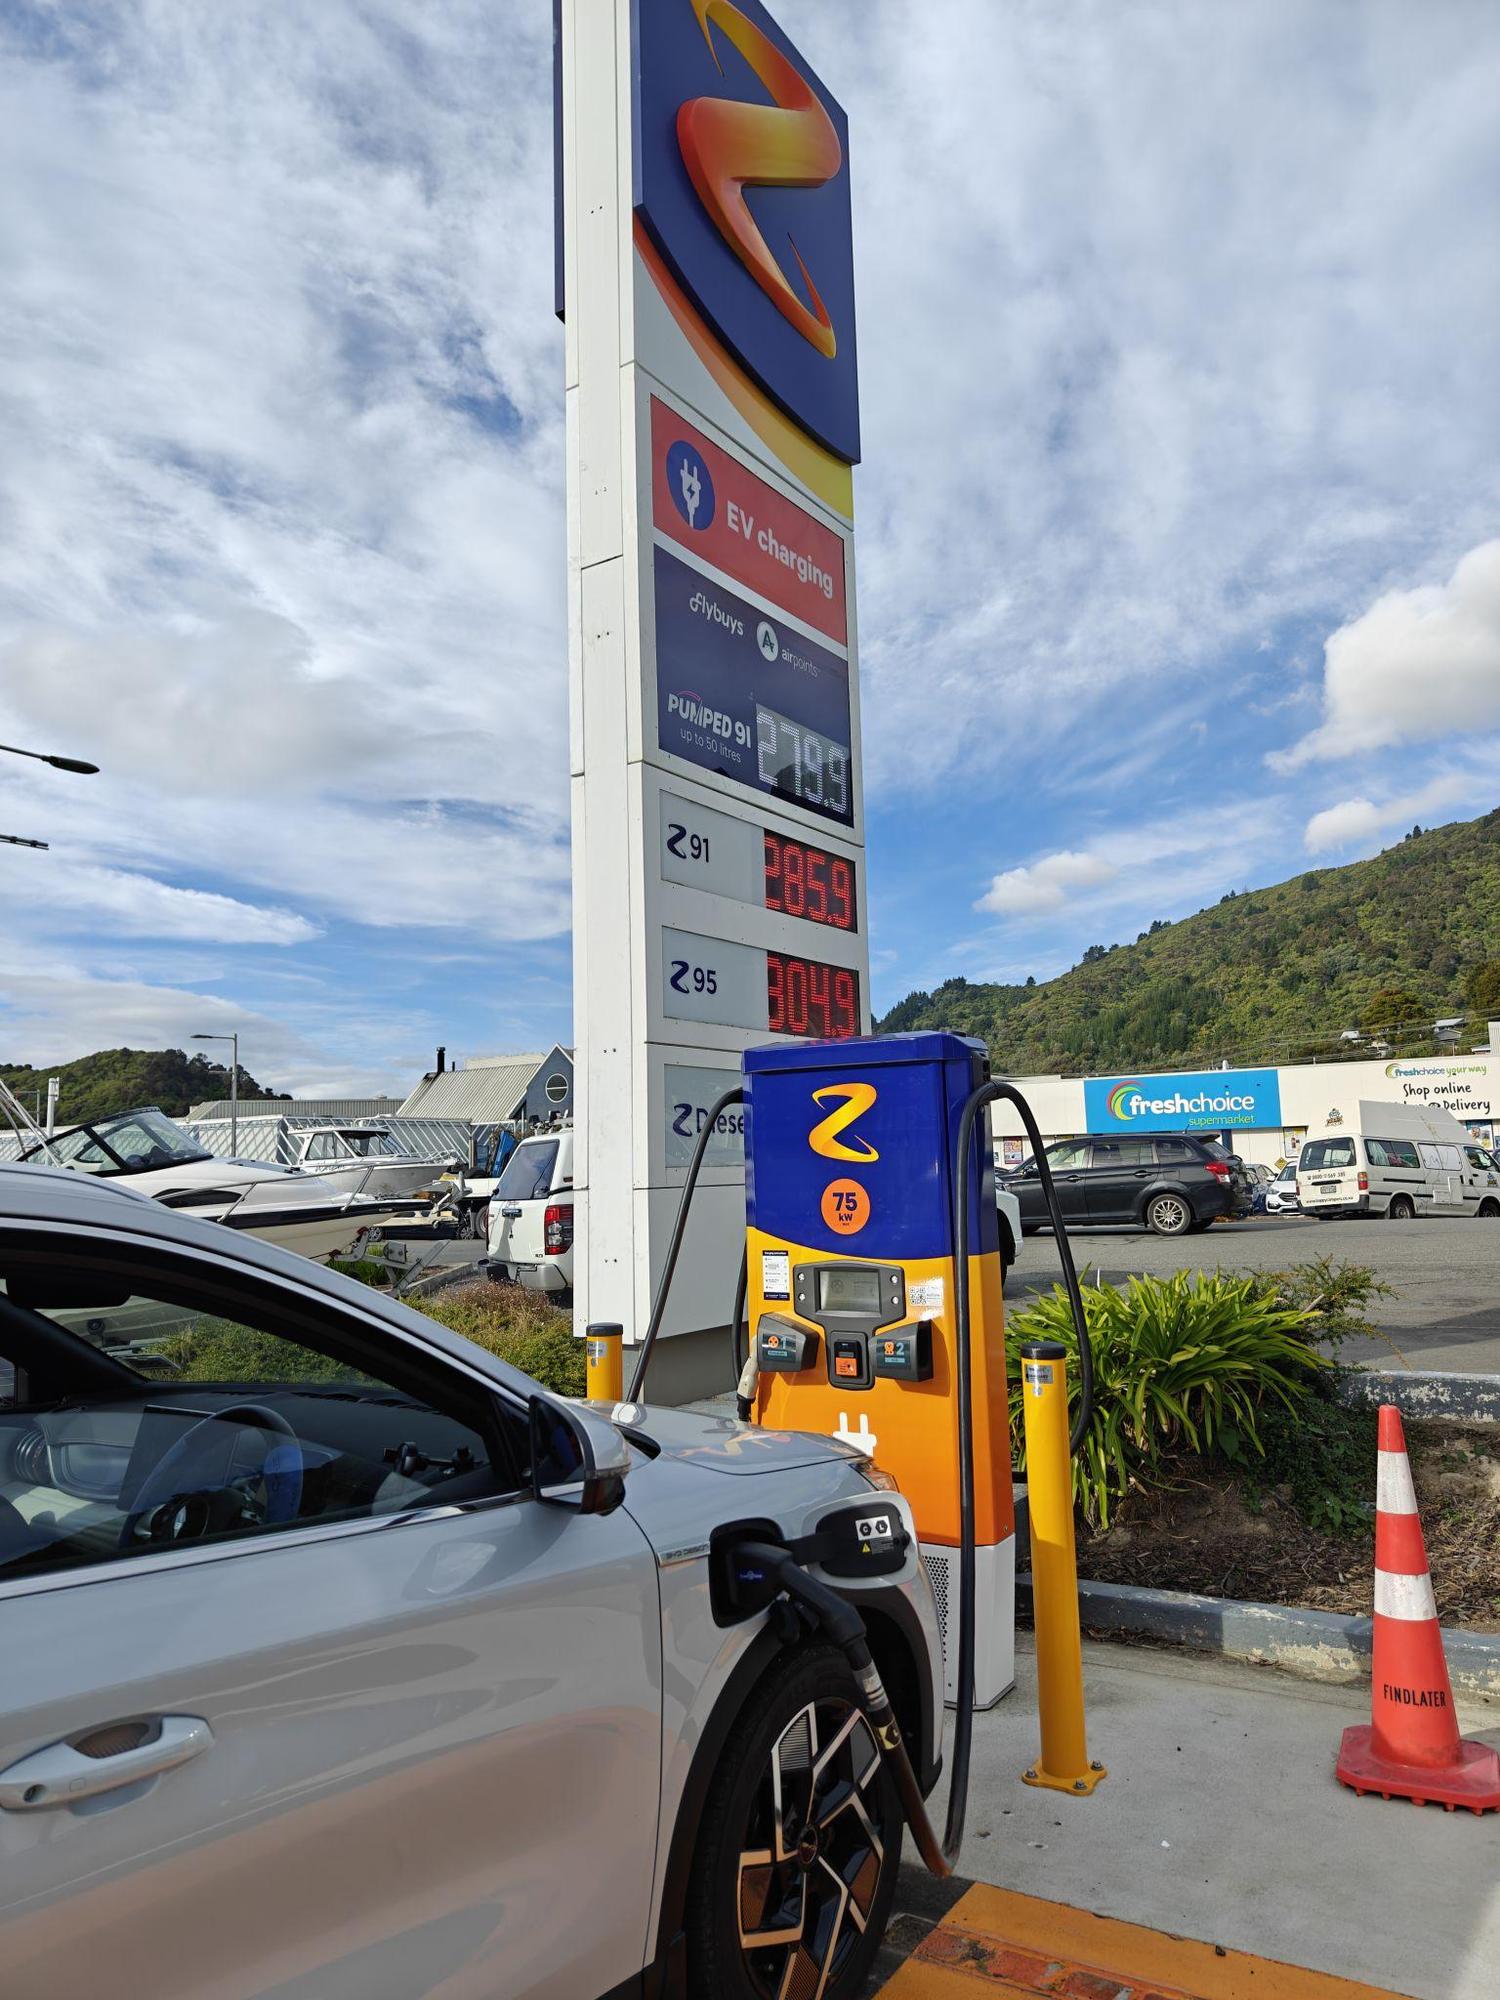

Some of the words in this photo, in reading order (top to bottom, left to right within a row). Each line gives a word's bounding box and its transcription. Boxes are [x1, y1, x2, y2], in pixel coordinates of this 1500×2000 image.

[727, 500, 754, 541] EV
[758, 528, 833, 599] charging
[690, 593, 744, 636] flybuys
[781, 648, 818, 678] airpoints
[667, 693, 732, 738] PUMPED
[735, 720, 752, 749] 91
[680, 728, 691, 743] up
[694, 732, 704, 747] to
[706, 736, 718, 753] 50
[719, 740, 742, 764] litres
[690, 833, 710, 863] 91
[693, 968, 718, 995] 95
[1395, 1066, 1446, 1077] freshchoice
[1446, 1065, 1467, 1077] your
[1468, 1065, 1487, 1076] way
[1403, 1083, 1430, 1100] Shop
[1434, 1081, 1472, 1094] online
[1129, 1091, 1255, 1116] freshchoice
[1442, 1099, 1491, 1115] Delivery
[1189, 1113, 1256, 1127] supermarket
[832, 1192, 857, 1212] 75
[838, 1213, 853, 1222] kW
[896, 1342, 905, 1356] 2
[1383, 1684, 1447, 1707] FINDLATER
